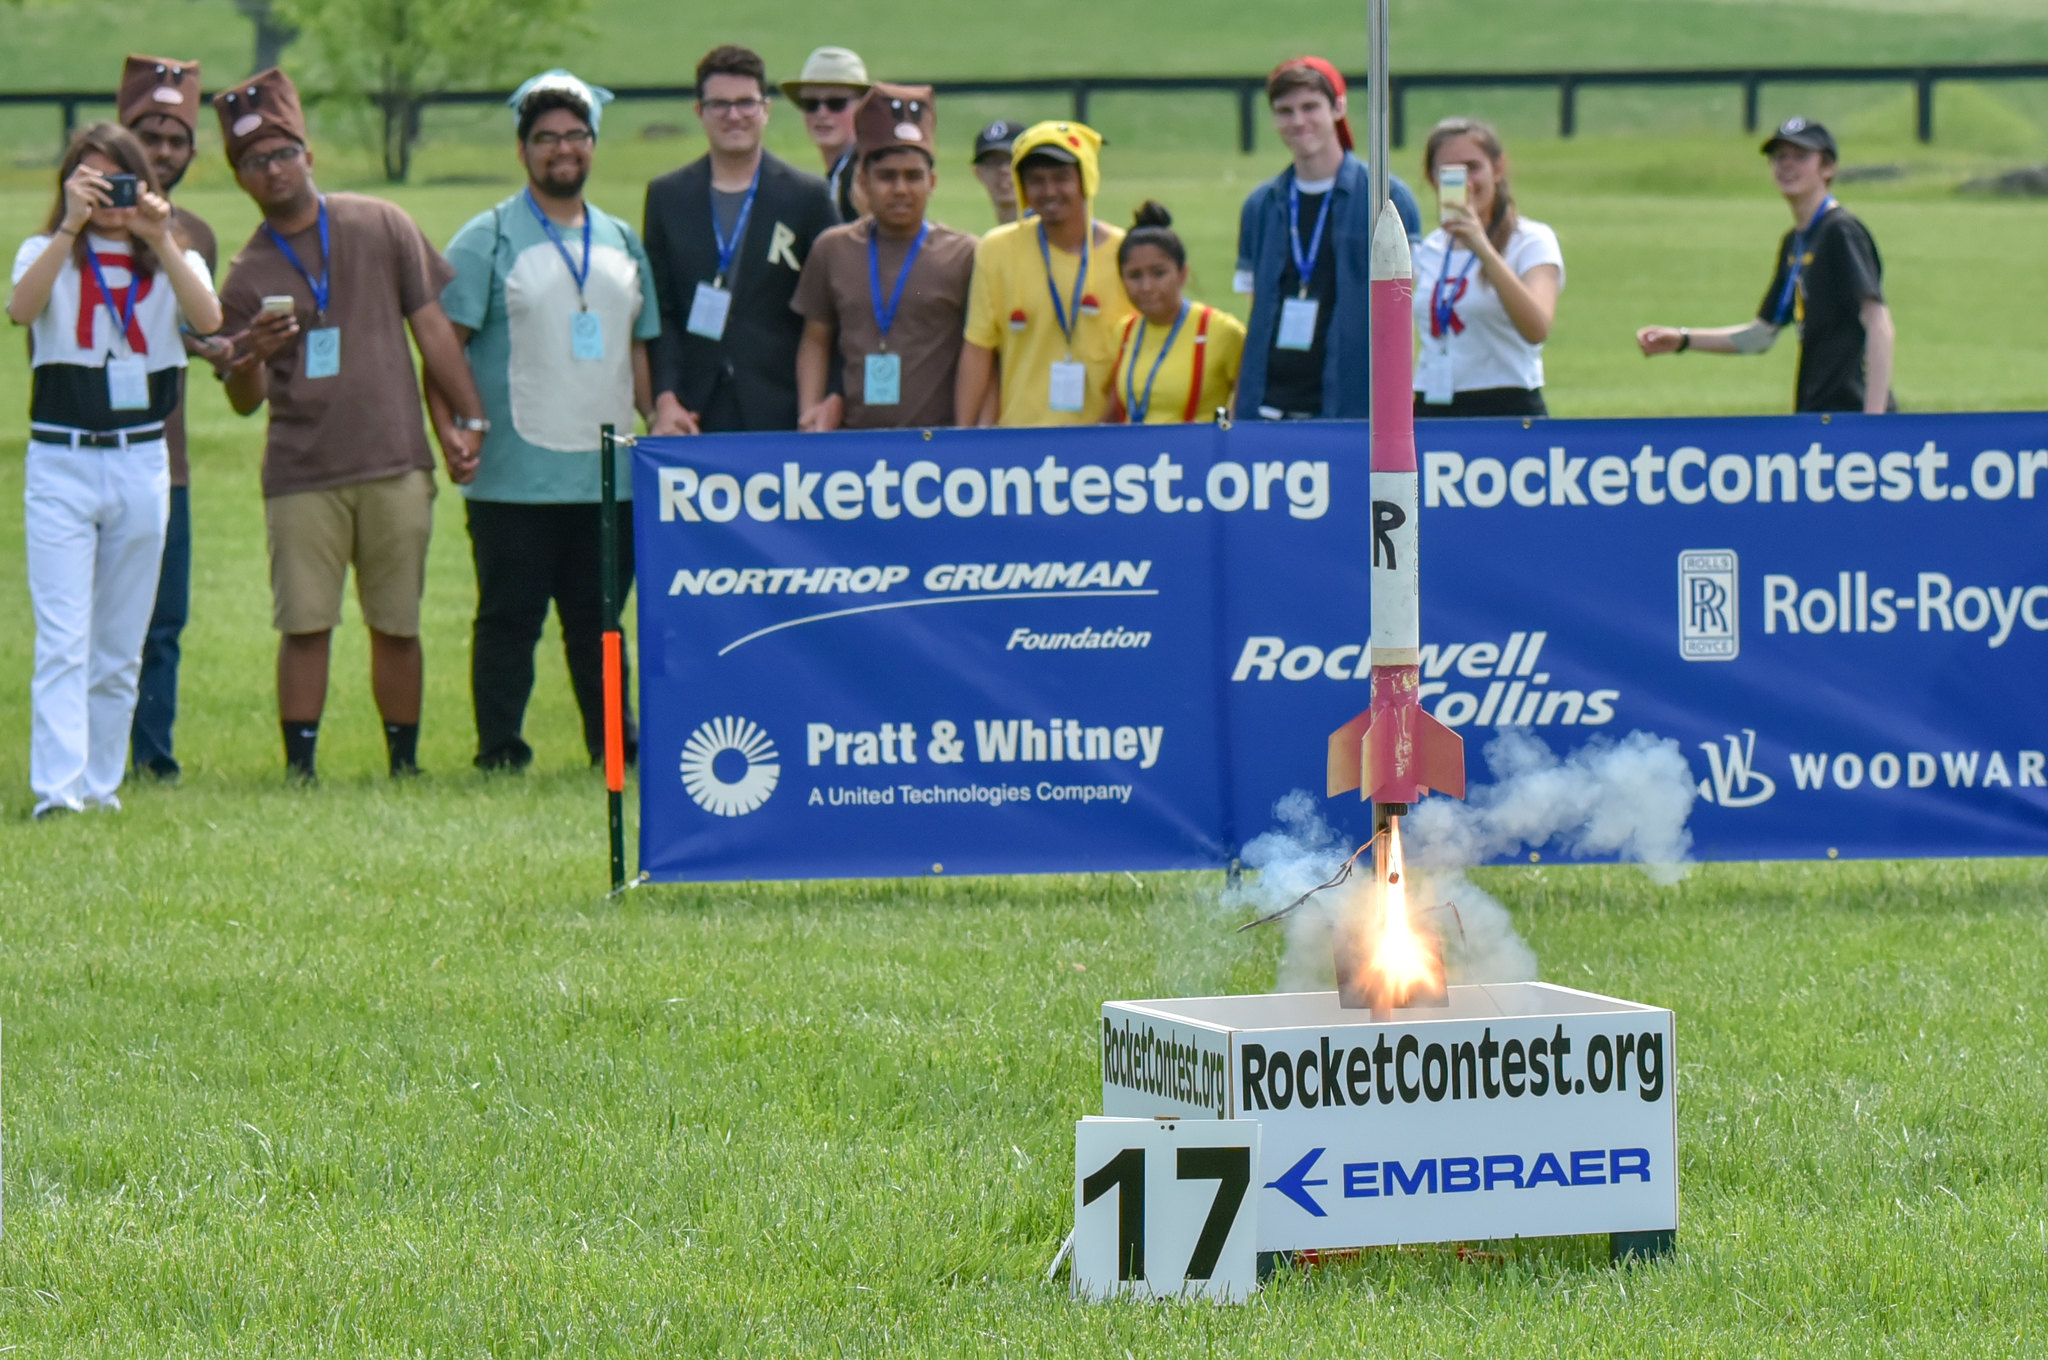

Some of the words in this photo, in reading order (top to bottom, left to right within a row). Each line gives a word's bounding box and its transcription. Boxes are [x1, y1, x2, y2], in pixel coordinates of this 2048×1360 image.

[767, 221, 801, 271] R
[77, 253, 153, 355] R
[1431, 278, 1468, 339] R
[658, 453, 1330, 522] RocketContest.org
[1372, 500, 1406, 571] R
[668, 565, 909, 596] NORTHROP
[923, 560, 1152, 591] GRUMMAN
[1687, 558, 1730, 569] ROLLS
[1689, 577, 1729, 633] RR
[1764, 571, 2048, 650] Rolls-Royc
[1006, 625, 1152, 651] Foundation
[1688, 641, 1729, 652] ROYCE
[807, 722, 918, 766] Pratt
[927, 720, 965, 763] &
[974, 719, 1164, 769] Whitney
[1789, 750, 2047, 790] WOODWAR
[808, 788, 824, 806] A
[828, 786, 895, 806] United
[899, 783, 1032, 807] Technologies
[1036, 781, 1133, 804] Company
[1103, 1016, 1225, 1120] RocketContest.org
[1242, 1023, 1664, 1111] RocketContest.org
[1343, 1147, 1651, 1199] EMBRAER
[1083, 1146, 1251, 1281] 17
